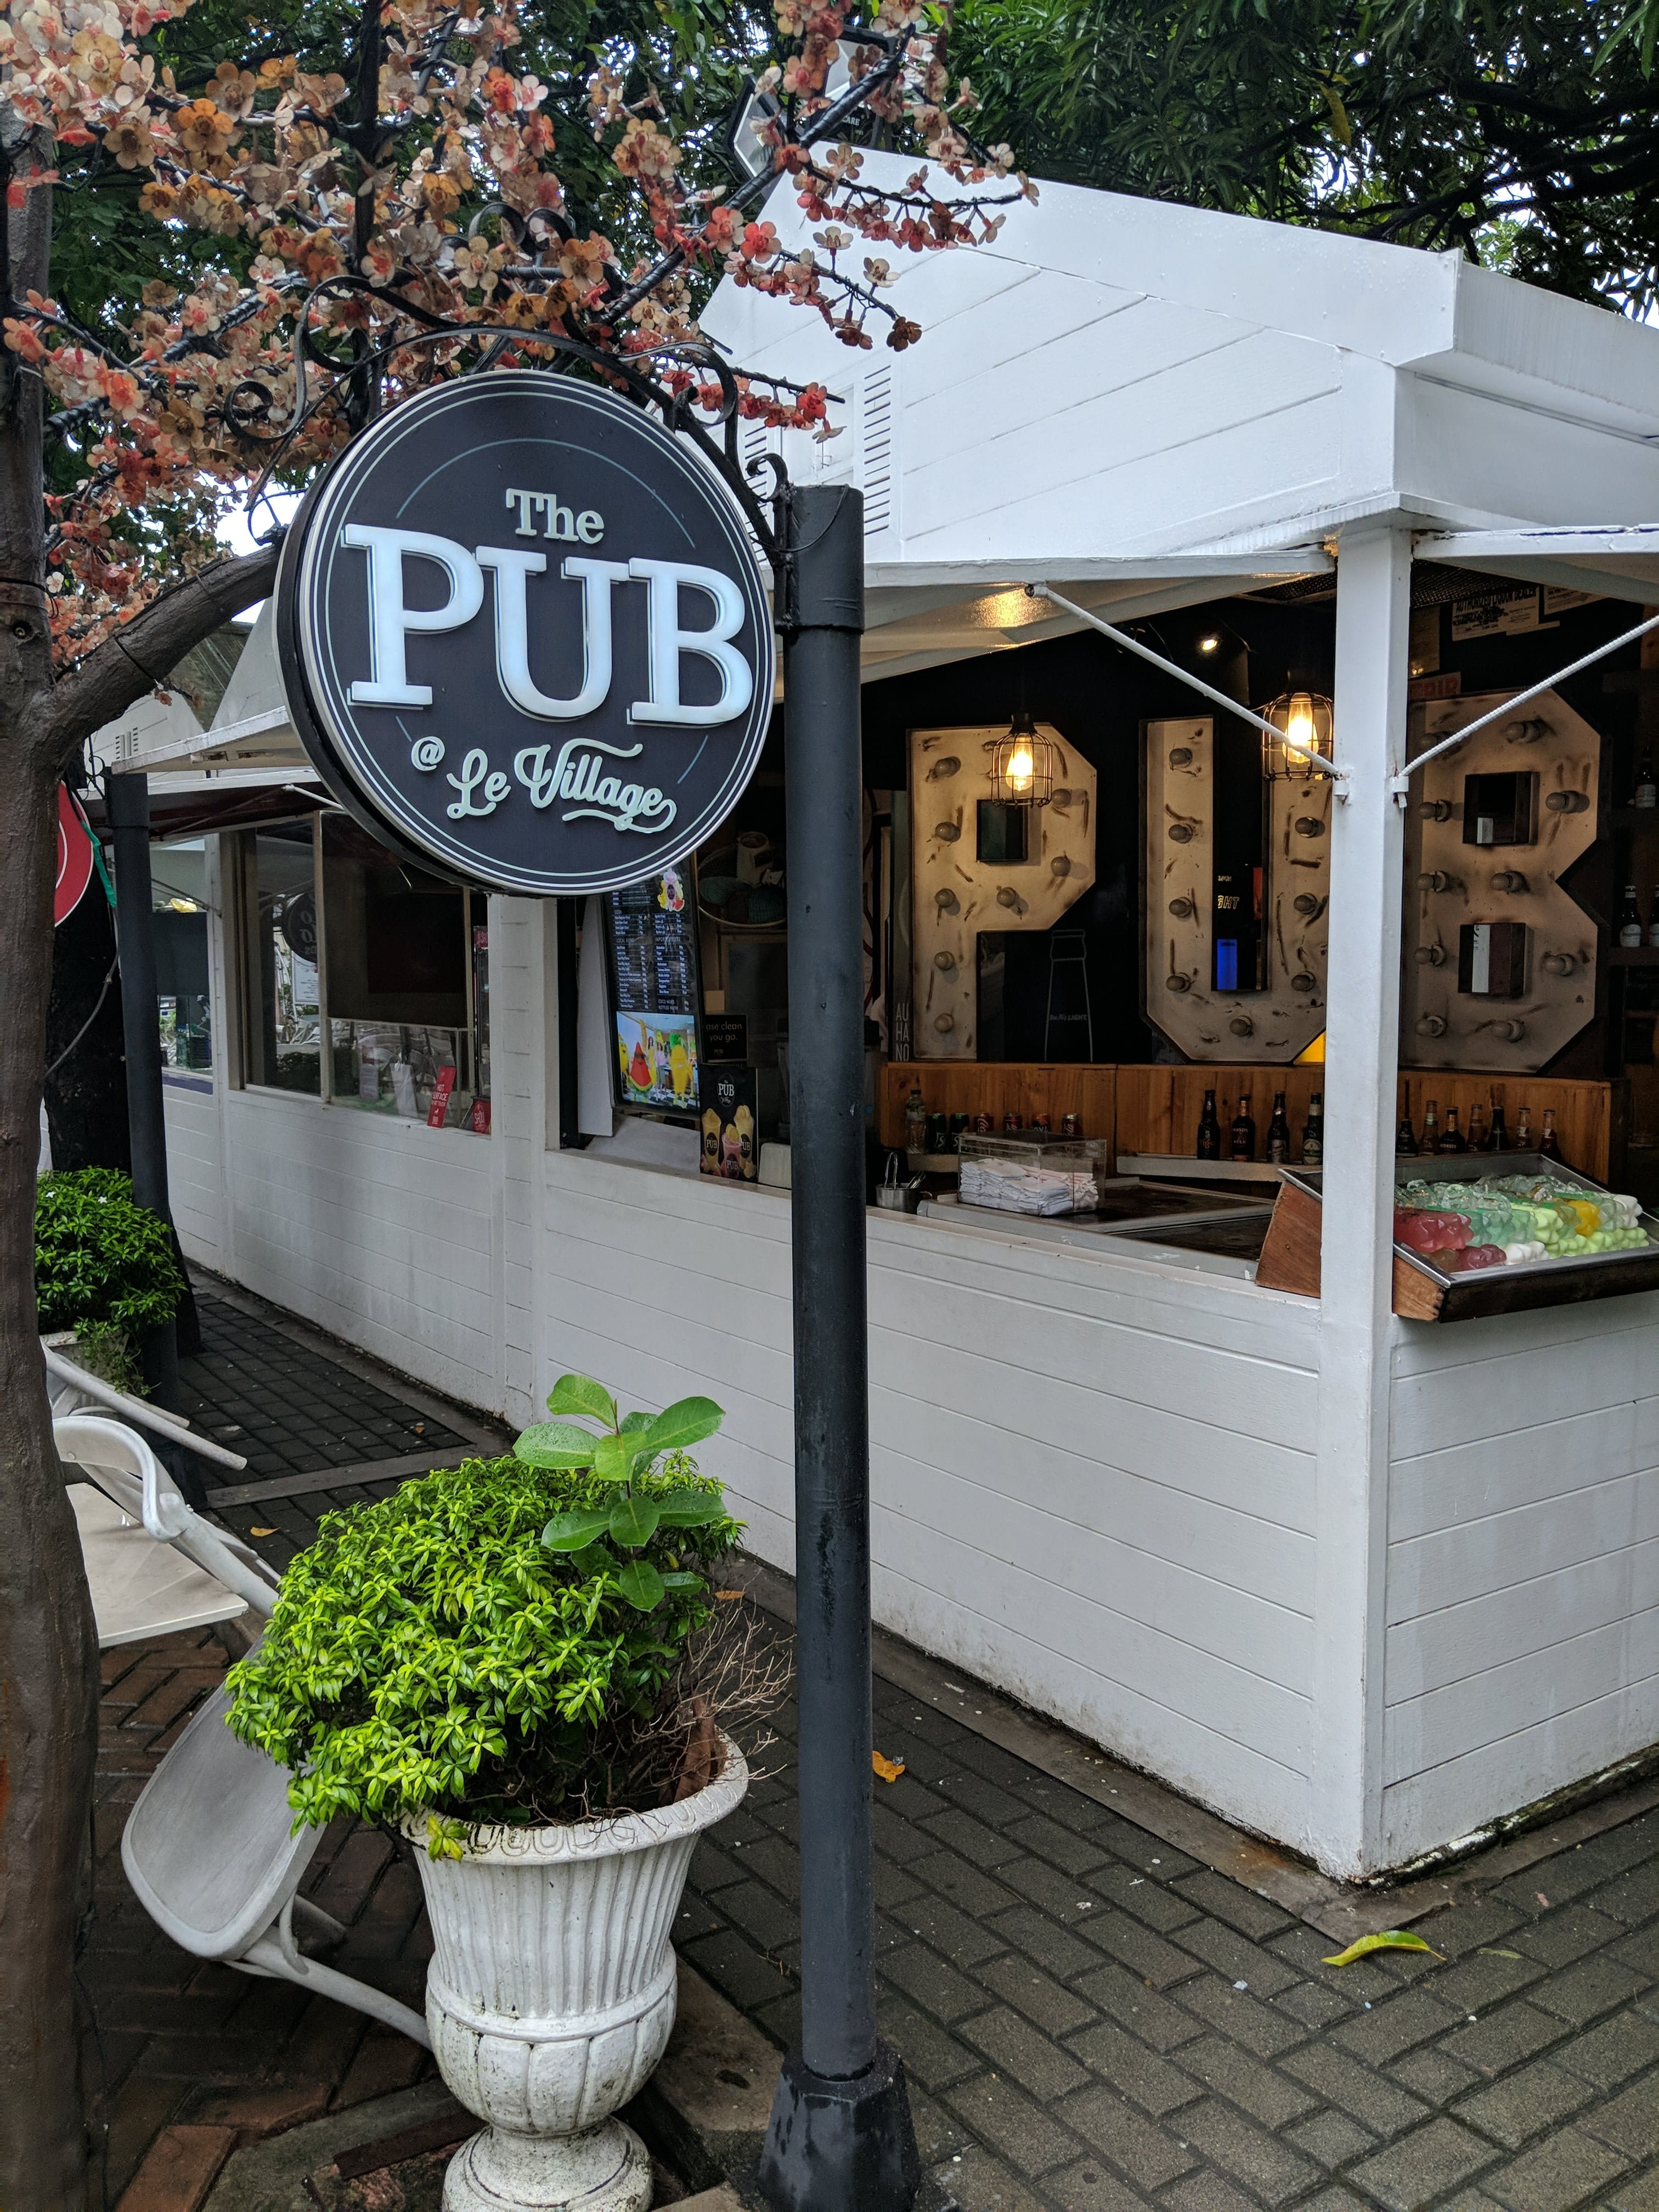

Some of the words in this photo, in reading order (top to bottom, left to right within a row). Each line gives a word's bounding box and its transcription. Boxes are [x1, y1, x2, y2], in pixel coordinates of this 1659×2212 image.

[505, 488, 605, 544] The
[341, 523, 753, 729] PUB
[410, 735, 445, 771] @
[445, 747, 511, 820] Le
[514, 737, 678, 834] Village
[721, 1021, 742, 1031] clean
[709, 1035, 723, 1043] you
[725, 1034, 738, 1043] go.
[718, 1083, 735, 1097] PUB
[706, 1139, 718, 1149] PUB
[726, 1160, 738, 1170] PUB
